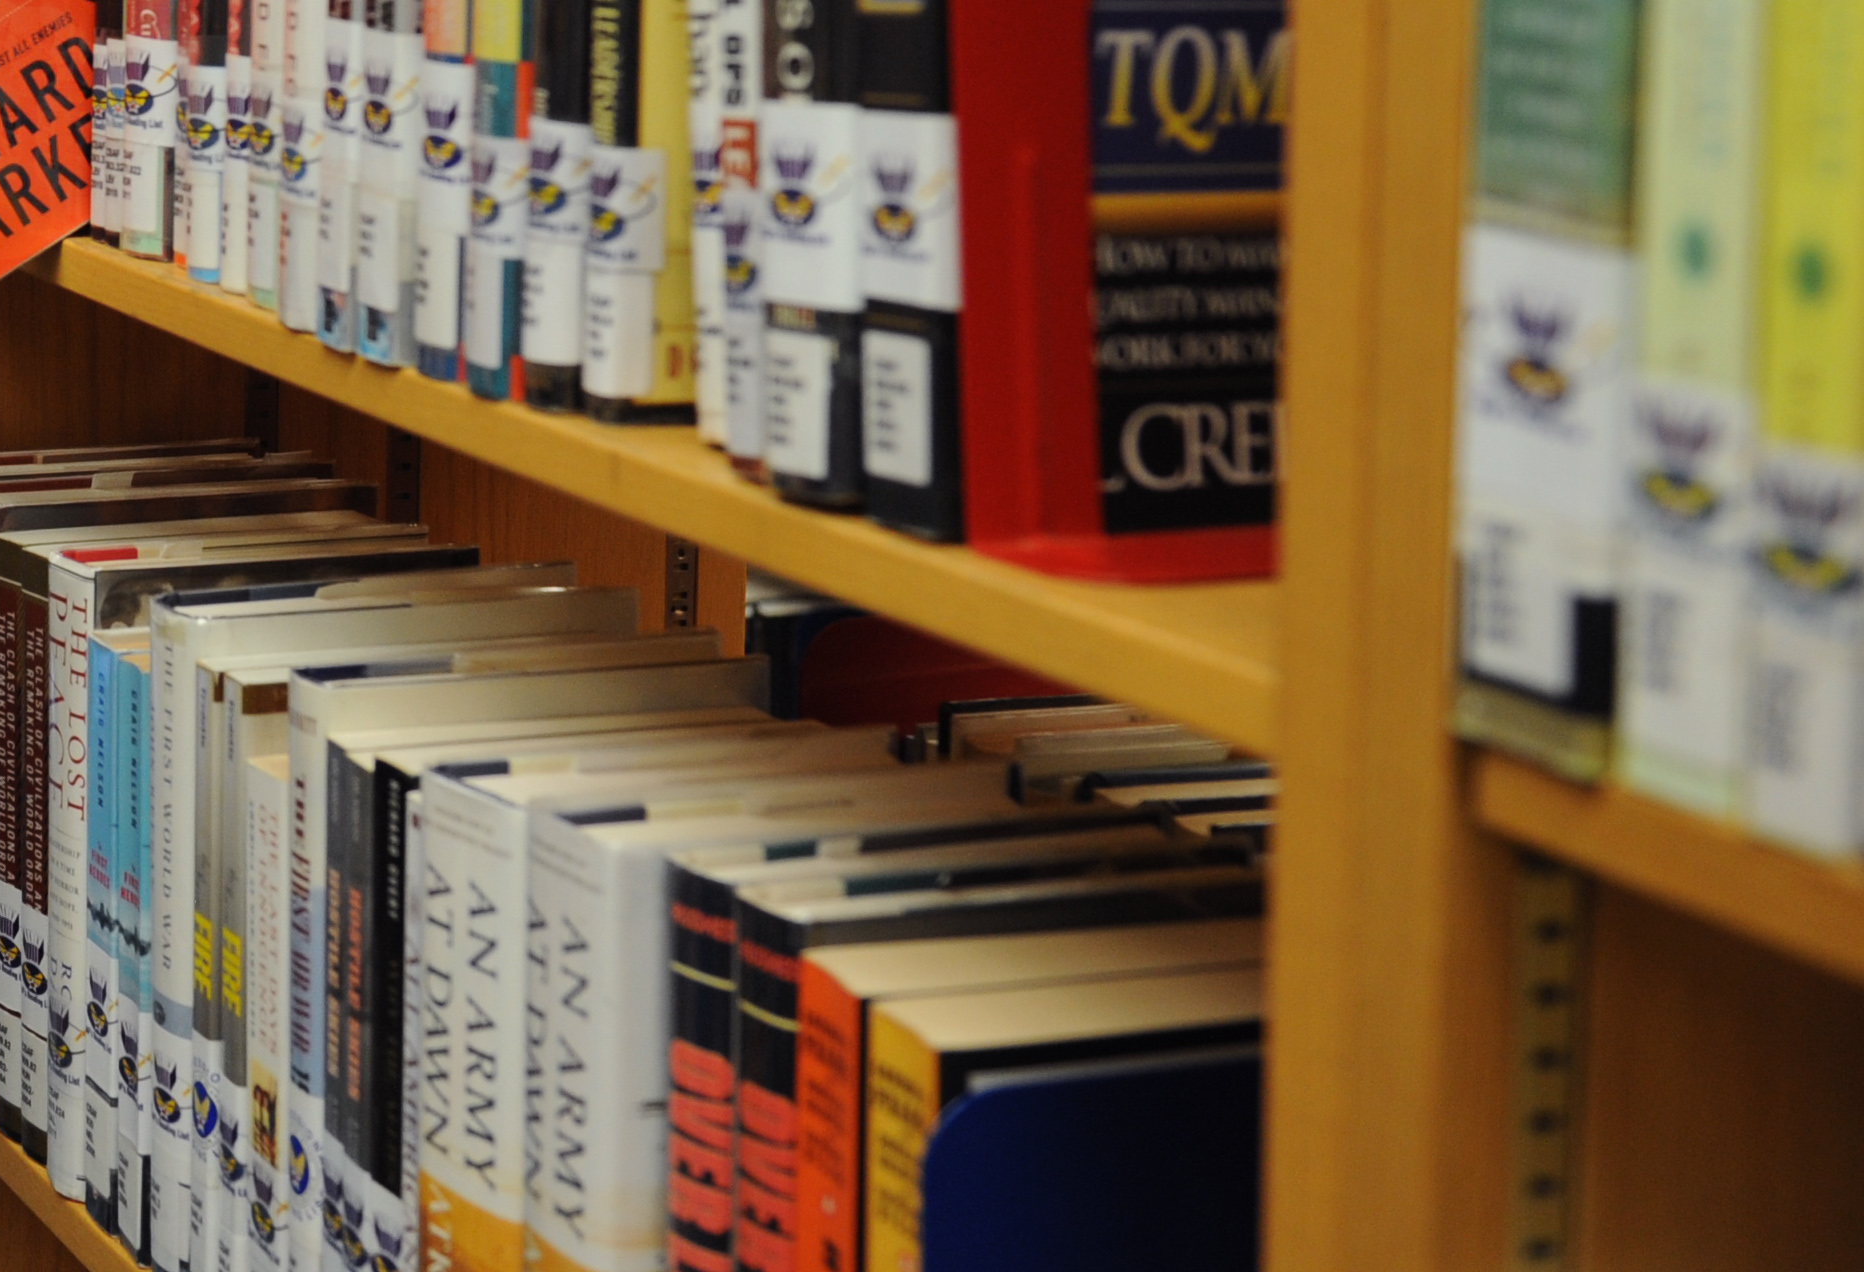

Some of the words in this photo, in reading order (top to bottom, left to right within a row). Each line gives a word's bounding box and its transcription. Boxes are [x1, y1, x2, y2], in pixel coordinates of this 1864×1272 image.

[12, 39, 30, 59] ALL
[31, 11, 73, 47] ENEMIES
[723, 35, 745, 108] OPS
[1094, 25, 1293, 154] TQM
[6, 610, 16, 639] THE
[25, 630, 35, 661] THE
[35, 627, 44, 651] THE
[70, 598, 89, 686] THE
[6, 648, 16, 706] CLASH
[35, 666, 44, 722] CLASH
[48, 591, 68, 809] PEACE
[97, 672, 105, 726] CRAIG
[162, 645, 173, 695] THE
[6, 711, 16, 731] OF
[25, 668, 35, 762] REMAKING
[35, 729, 44, 750] OF
[130, 690, 138, 746] CRAIG
[162, 708, 173, 786] FIRST
[25, 767, 35, 787] OF
[67, 708, 87, 822] LOST
[97, 737, 105, 808] NELSON
[130, 757, 138, 830] NELSON
[6, 739, 16, 865] CIVILIZATIONS
[25, 793, 34, 851] WORLD
[34, 758, 43, 884] CIVILIZATIONS
[25, 857, 34, 906] ORDE
[89, 865, 110, 891] HEROES
[91, 849, 108, 871] FIRST
[161, 803, 173, 901] WORLD
[426, 863, 454, 947] AT
[468, 880, 500, 980] AN
[162, 913, 173, 971] WAR
[194, 911, 214, 1002] FIRE
[222, 926, 242, 1019] FIRE
[560, 916, 591, 1019] AN
[423, 964, 454, 1156] DAWN
[464, 995, 498, 1192] ARMY
[553, 1034, 587, 1242] ARMY
